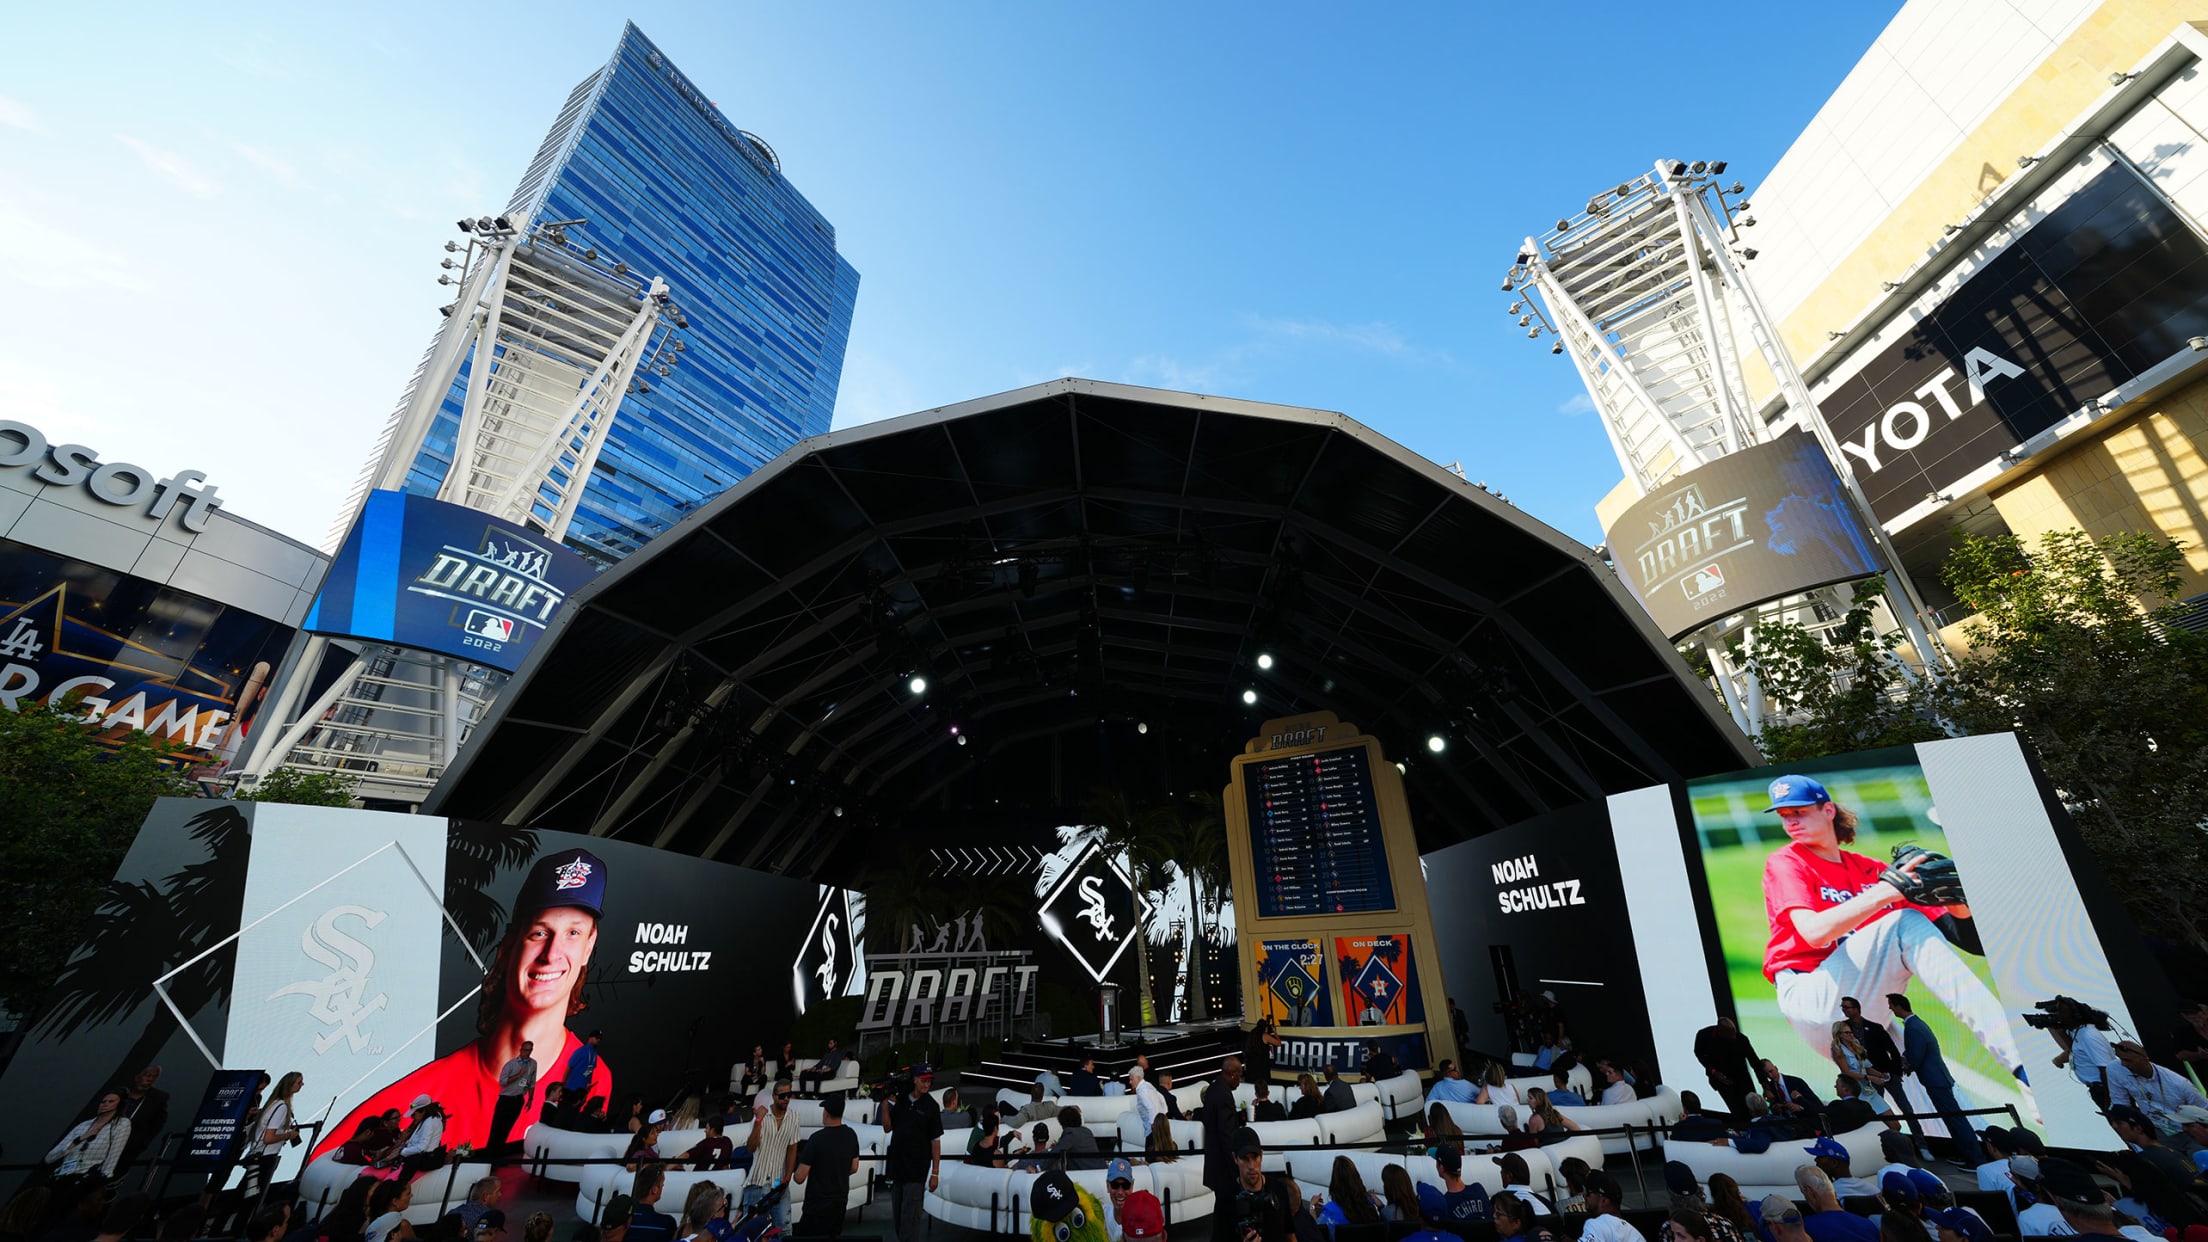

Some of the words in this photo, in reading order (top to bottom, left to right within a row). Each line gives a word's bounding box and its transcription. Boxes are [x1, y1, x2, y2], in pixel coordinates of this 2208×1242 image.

[1841, 346, 2026, 474] YOTA
[0, 420, 224, 533] osoft
[1638, 505, 1748, 587] DRAFT
[418, 552, 562, 621] DRAFT
[1693, 589, 1727, 610] 2022
[463, 636, 503, 652] 2022
[48, 676, 237, 751] GAME
[1271, 726, 1327, 750] DRAFT
[1491, 855, 1539, 884] NOAH
[1498, 879, 1585, 914] SCHULTZ
[635, 923, 688, 945] NOAH
[628, 951, 712, 974] SCHULTZ
[1300, 954, 1323, 966] 2:27
[856, 965, 1039, 1030] DRAFT
[1275, 1040, 1359, 1068] DRAFT
[1452, 1199, 1483, 1218] ICHIRO
